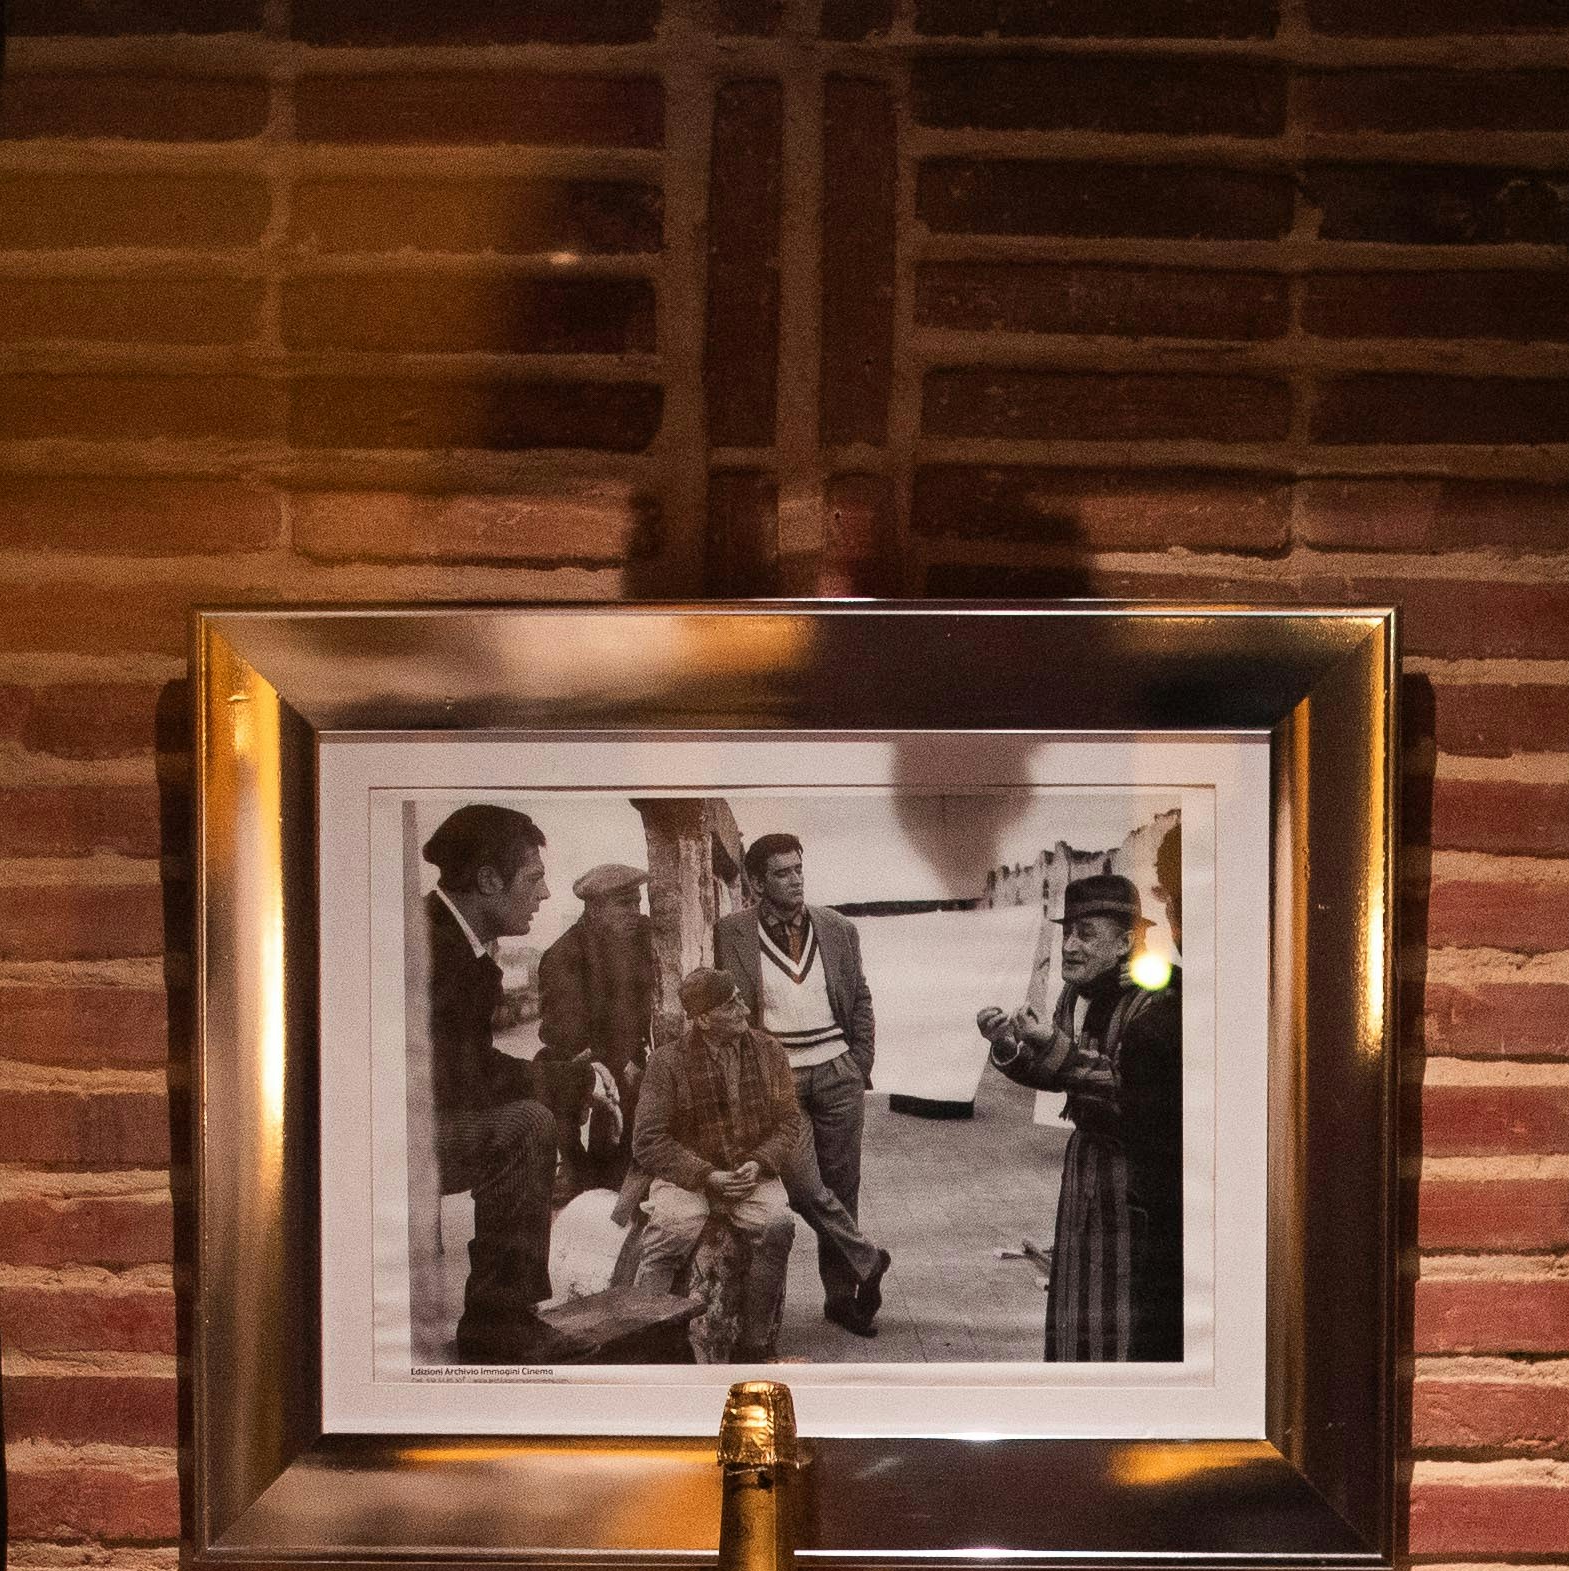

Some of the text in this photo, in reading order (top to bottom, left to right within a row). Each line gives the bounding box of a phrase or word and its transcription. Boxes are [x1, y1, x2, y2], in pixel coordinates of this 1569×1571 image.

[410, 1367, 443, 1376] Edizioni
[445, 1367, 479, 1376] Archivio
[521, 1367, 554, 1376] Cinema
